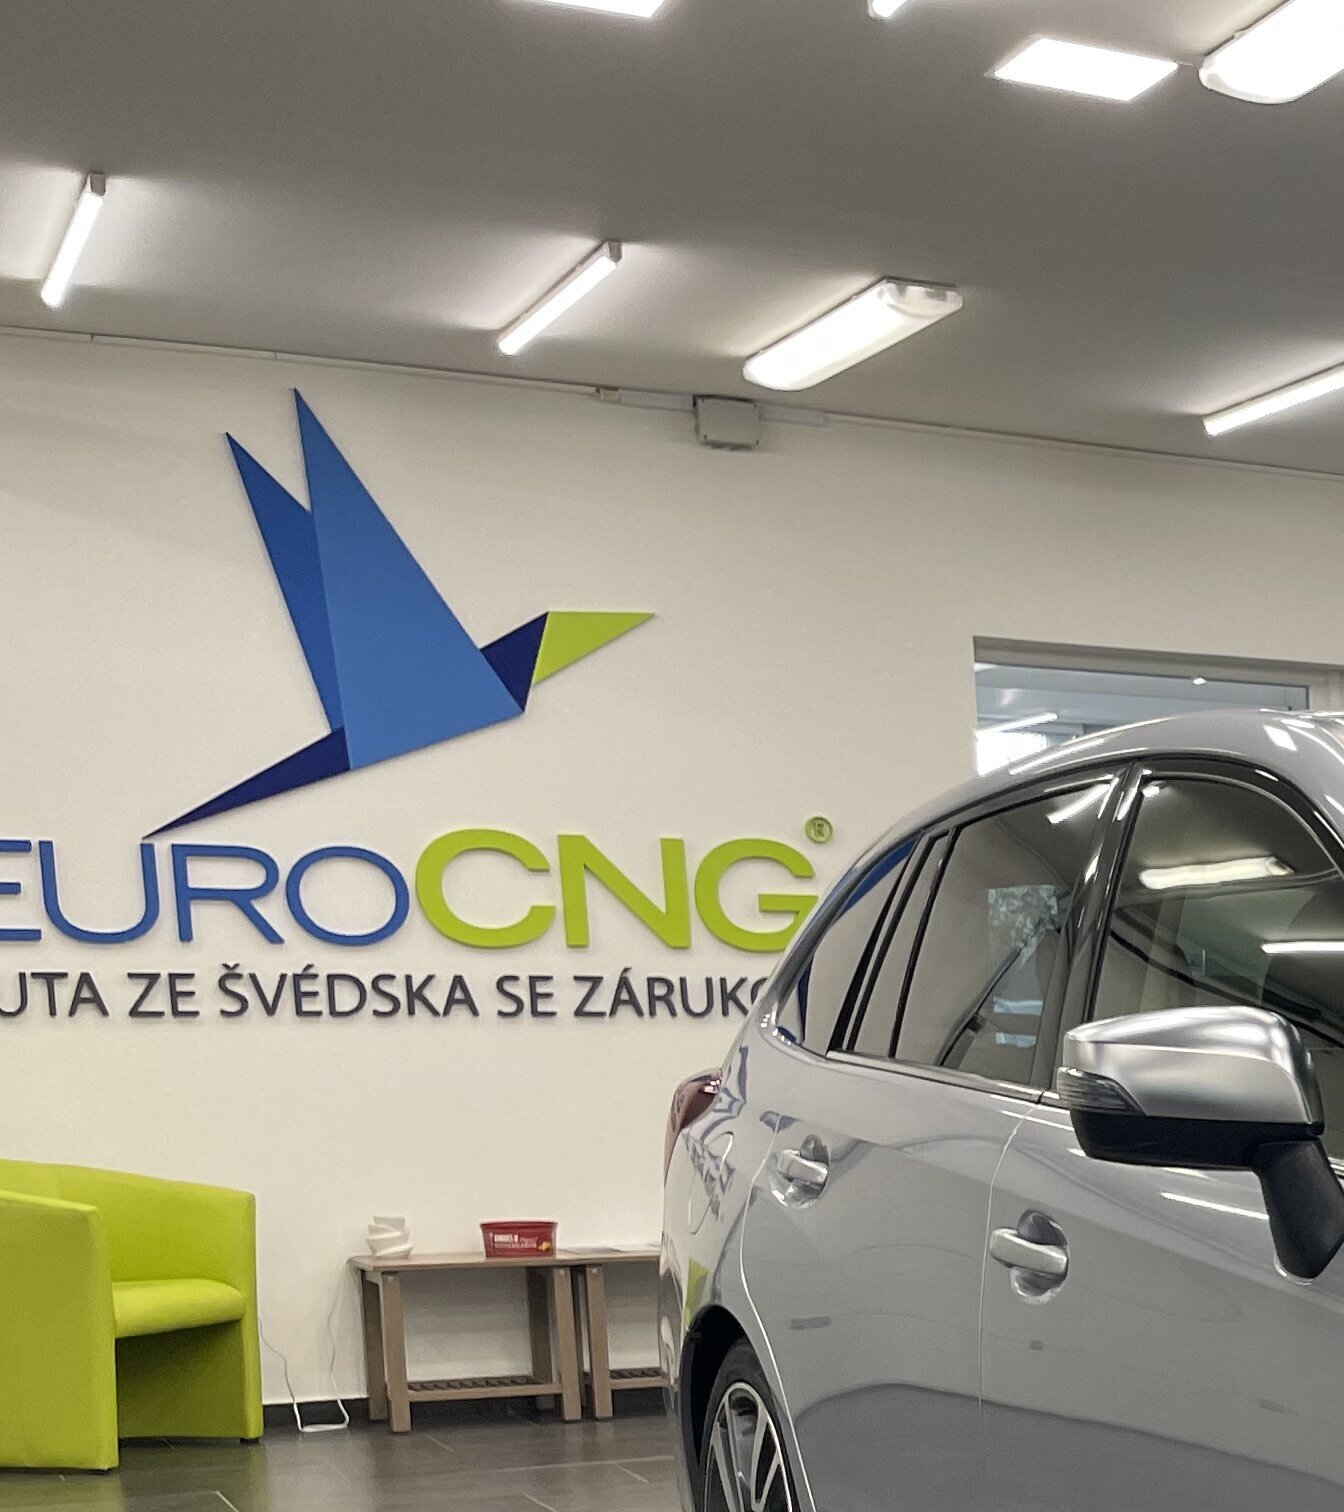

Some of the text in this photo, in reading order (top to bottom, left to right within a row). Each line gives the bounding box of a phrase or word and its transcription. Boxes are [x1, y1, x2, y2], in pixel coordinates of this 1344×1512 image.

[127, 971, 201, 1018] ZE
[217, 963, 480, 1018] ŠVÉDSKA
[496, 974, 556, 1018] SE
[572, 966, 768, 1019] ZÁRUK
